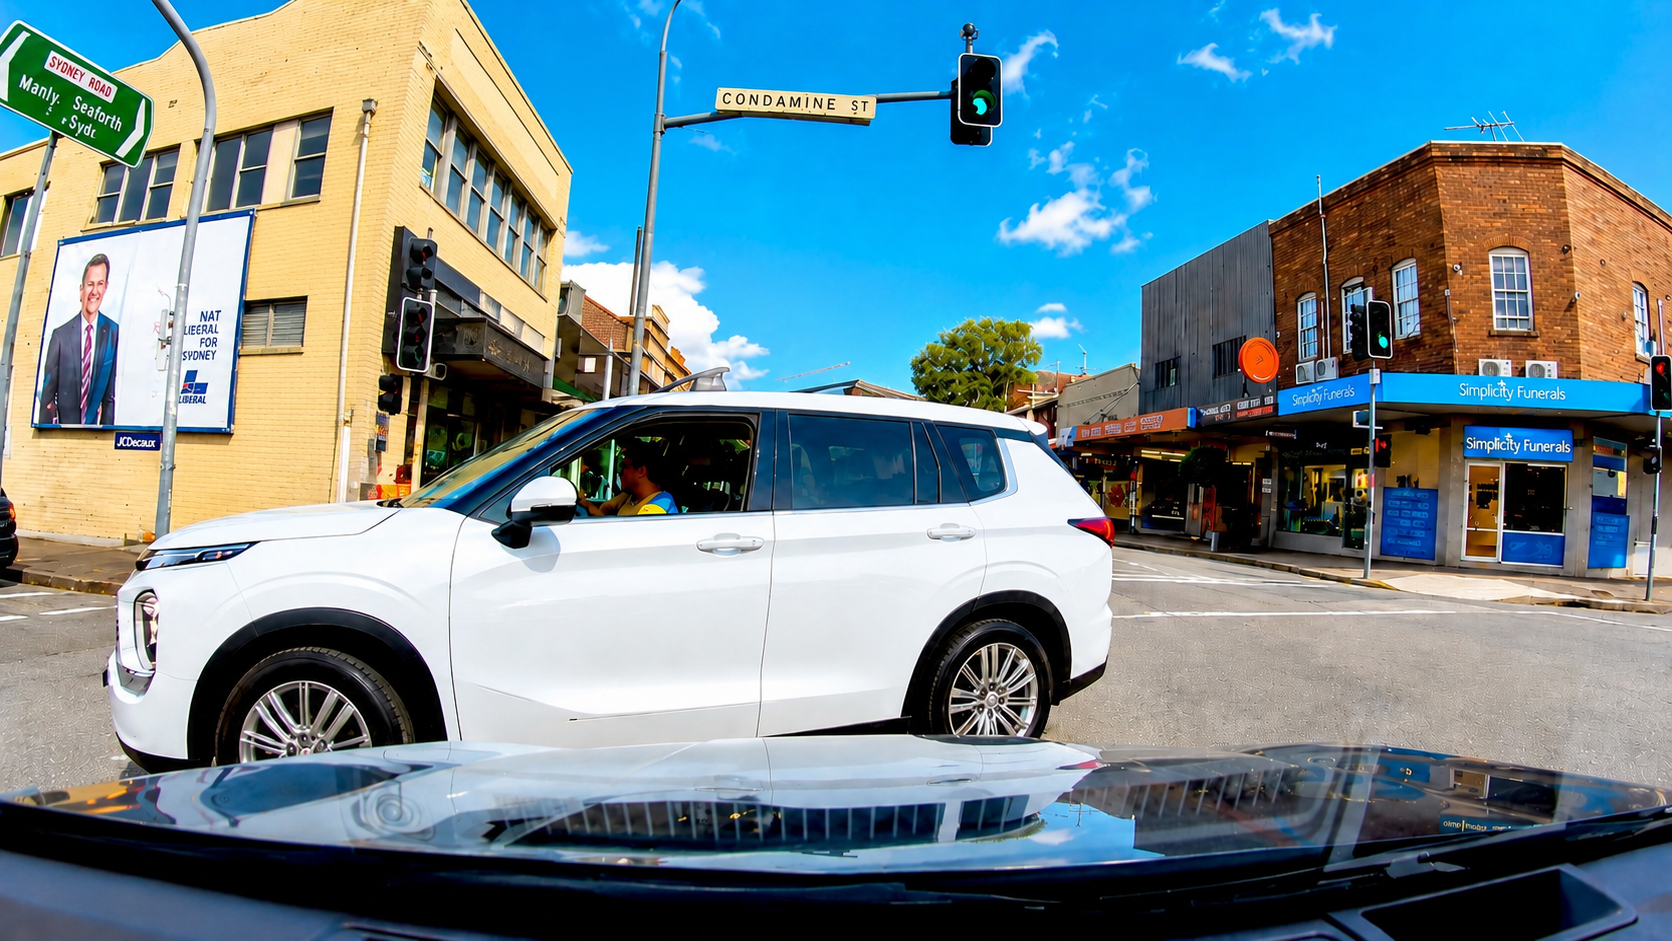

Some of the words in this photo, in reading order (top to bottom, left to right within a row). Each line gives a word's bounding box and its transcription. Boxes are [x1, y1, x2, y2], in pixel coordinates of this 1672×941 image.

[49, 55, 86, 82] SYDNEY
[88, 76, 112, 98] ROAD
[722, 92, 836, 111] CONDAMINE
[851, 100, 869, 112] ST
[72, 95, 122, 132] Seaforth
[199, 309, 222, 322] NAT
[199, 337, 218, 348] FOR
[182, 349, 217, 361] SYDNEY
[1459, 381, 1514, 402] Simplicity
[1517, 385, 1567, 401] Funerals
[116, 436, 156, 447] JCDecaux
[1466, 436, 1521, 455] Simplicity
[1523, 438, 1571, 454] Funerals
